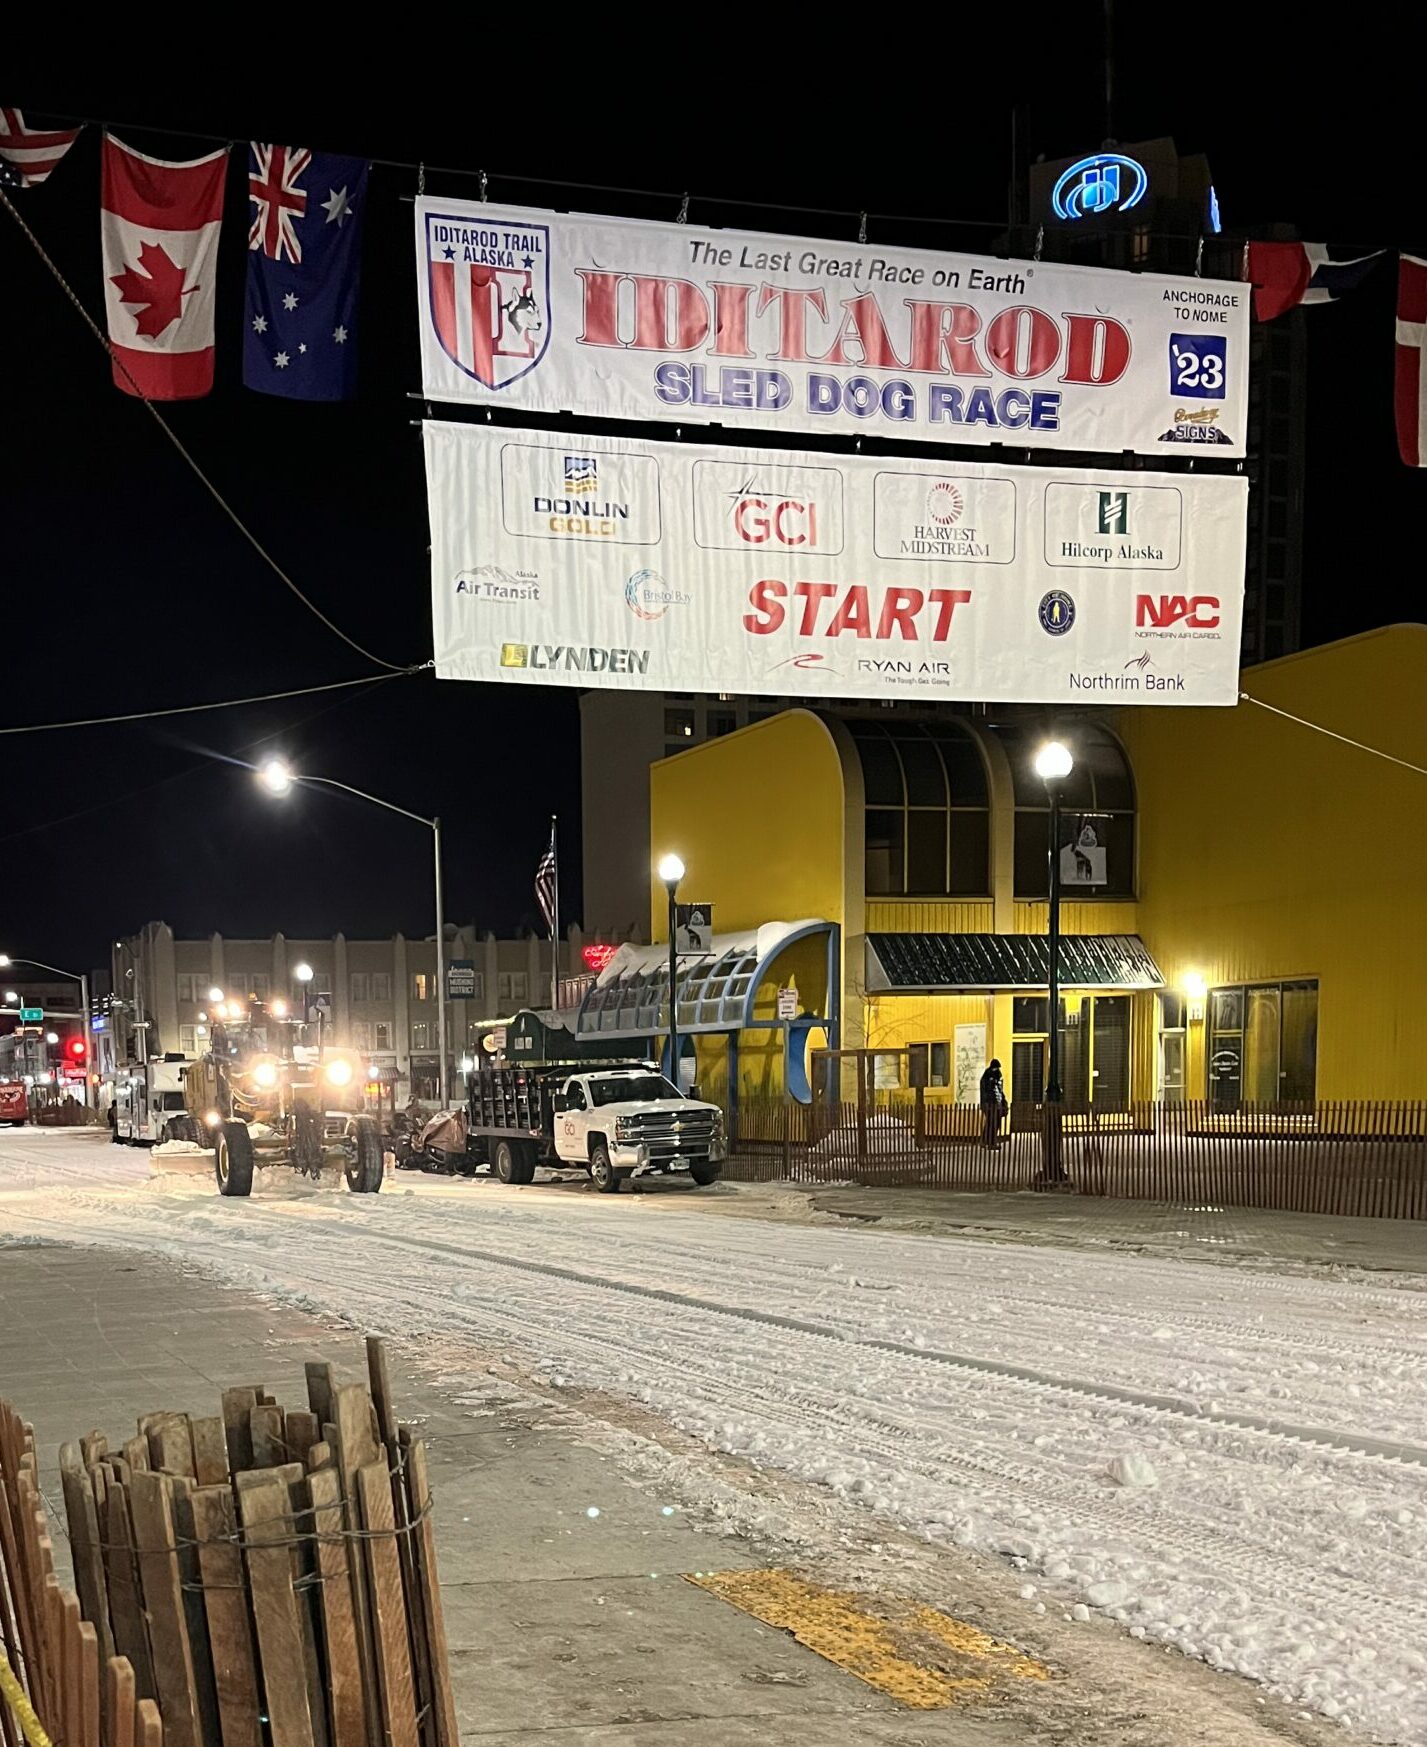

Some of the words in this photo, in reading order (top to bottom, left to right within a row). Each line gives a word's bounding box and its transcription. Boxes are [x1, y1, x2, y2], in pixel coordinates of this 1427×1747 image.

[434, 225, 498, 248] IDITAROD
[503, 233, 542, 252] TRAIL
[463, 246, 515, 267] ALASKA
[690, 241, 732, 265] The
[740, 246, 791, 272] Last
[799, 252, 862, 279] Great
[868, 259, 925, 285] Race
[932, 270, 960, 288] on
[1163, 289, 1239, 307] ANCHORAGE
[1174, 307, 1190, 320] TO
[1193, 309, 1228, 323] NOME
[575, 268, 1132, 387] IDITAROD
[654, 360, 793, 411] SLED
[806, 372, 917, 422] DOG
[929, 383, 1062, 432] RACE
[1176, 425, 1216, 439] SIGNS
[534, 497, 629, 519] DONLIN
[549, 517, 616, 536] GOLD
[734, 498, 817, 546] GCI
[913, 525, 977, 542] HARVEST
[900, 539, 990, 557] MIDSTREAM
[1061, 542, 1113, 562] Hilcorp
[1117, 544, 1163, 560] Alaska
[456, 580, 481, 595] Air
[483, 582, 540, 601] Transit
[742, 579, 972, 642] START
[1136, 594, 1220, 628] NAC
[529, 644, 651, 675] LYNDEN
[858, 659, 911, 673] RYAN
[919, 662, 950, 675] AIR
[1069, 673, 1140, 690] Northrim
[1145, 674, 1185, 691] Bank
